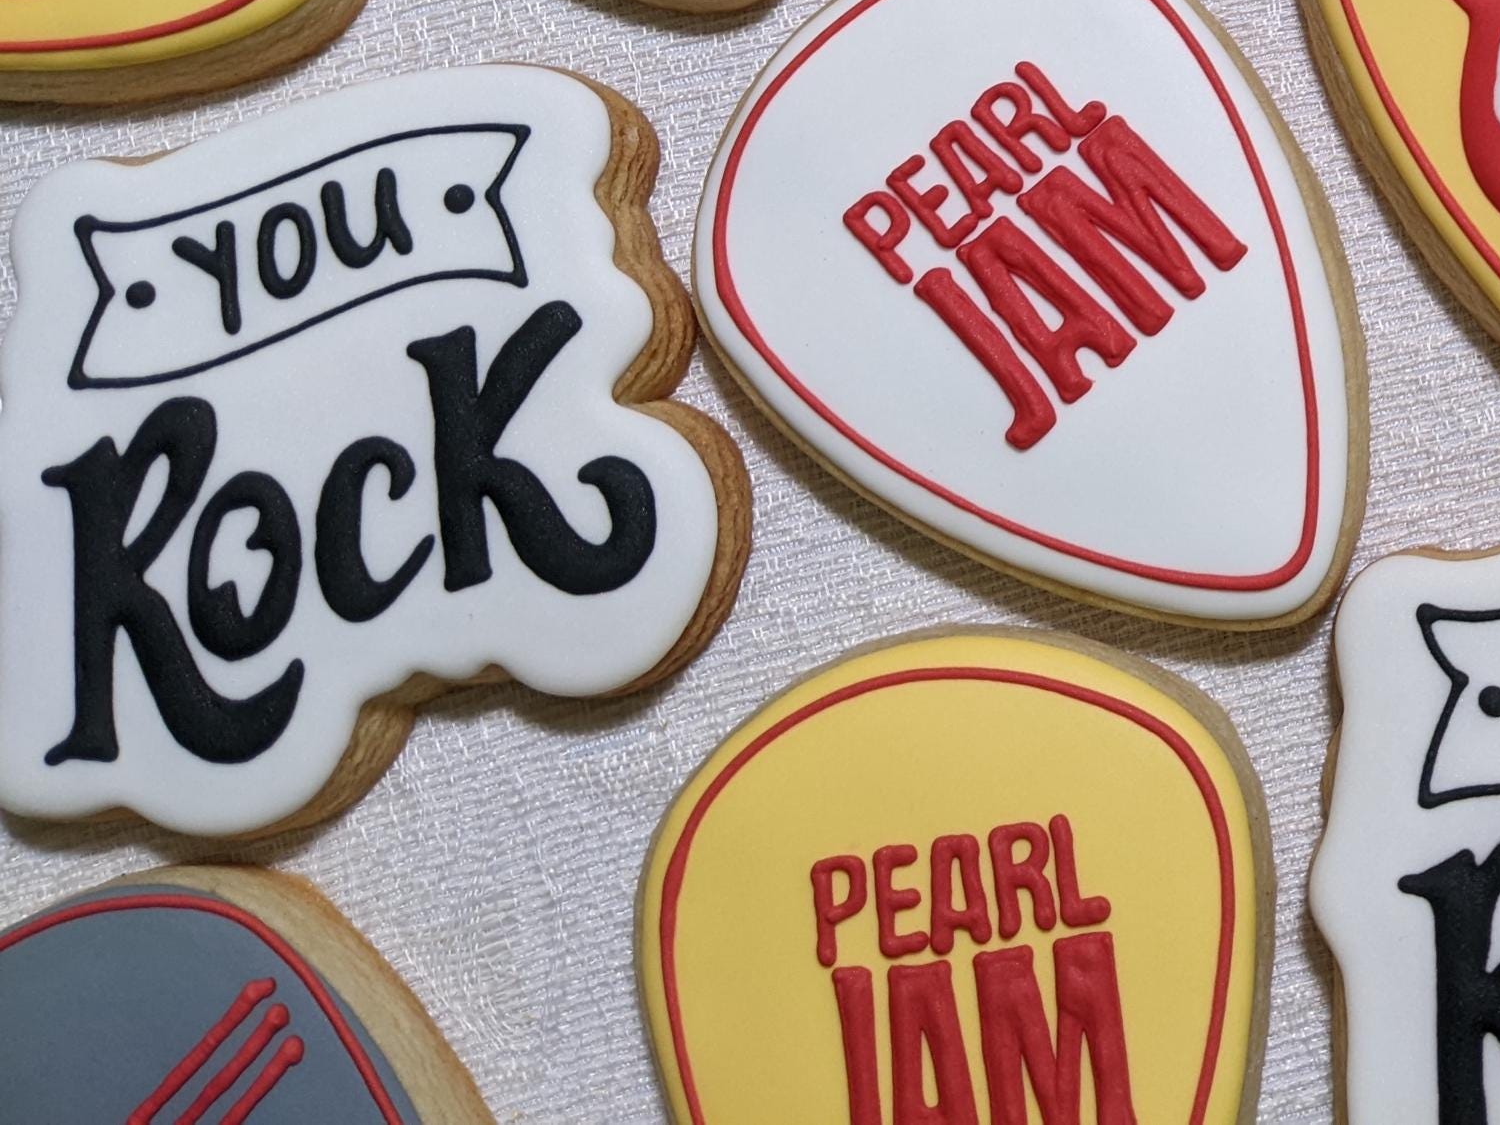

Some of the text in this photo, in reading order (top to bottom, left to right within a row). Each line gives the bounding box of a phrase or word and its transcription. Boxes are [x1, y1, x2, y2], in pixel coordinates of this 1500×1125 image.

[172, 167, 413, 335] YOU
[842, 61, 1107, 285] PEARL
[913, 115, 1248, 452] JAM
[810, 813, 1112, 967] PEARL
